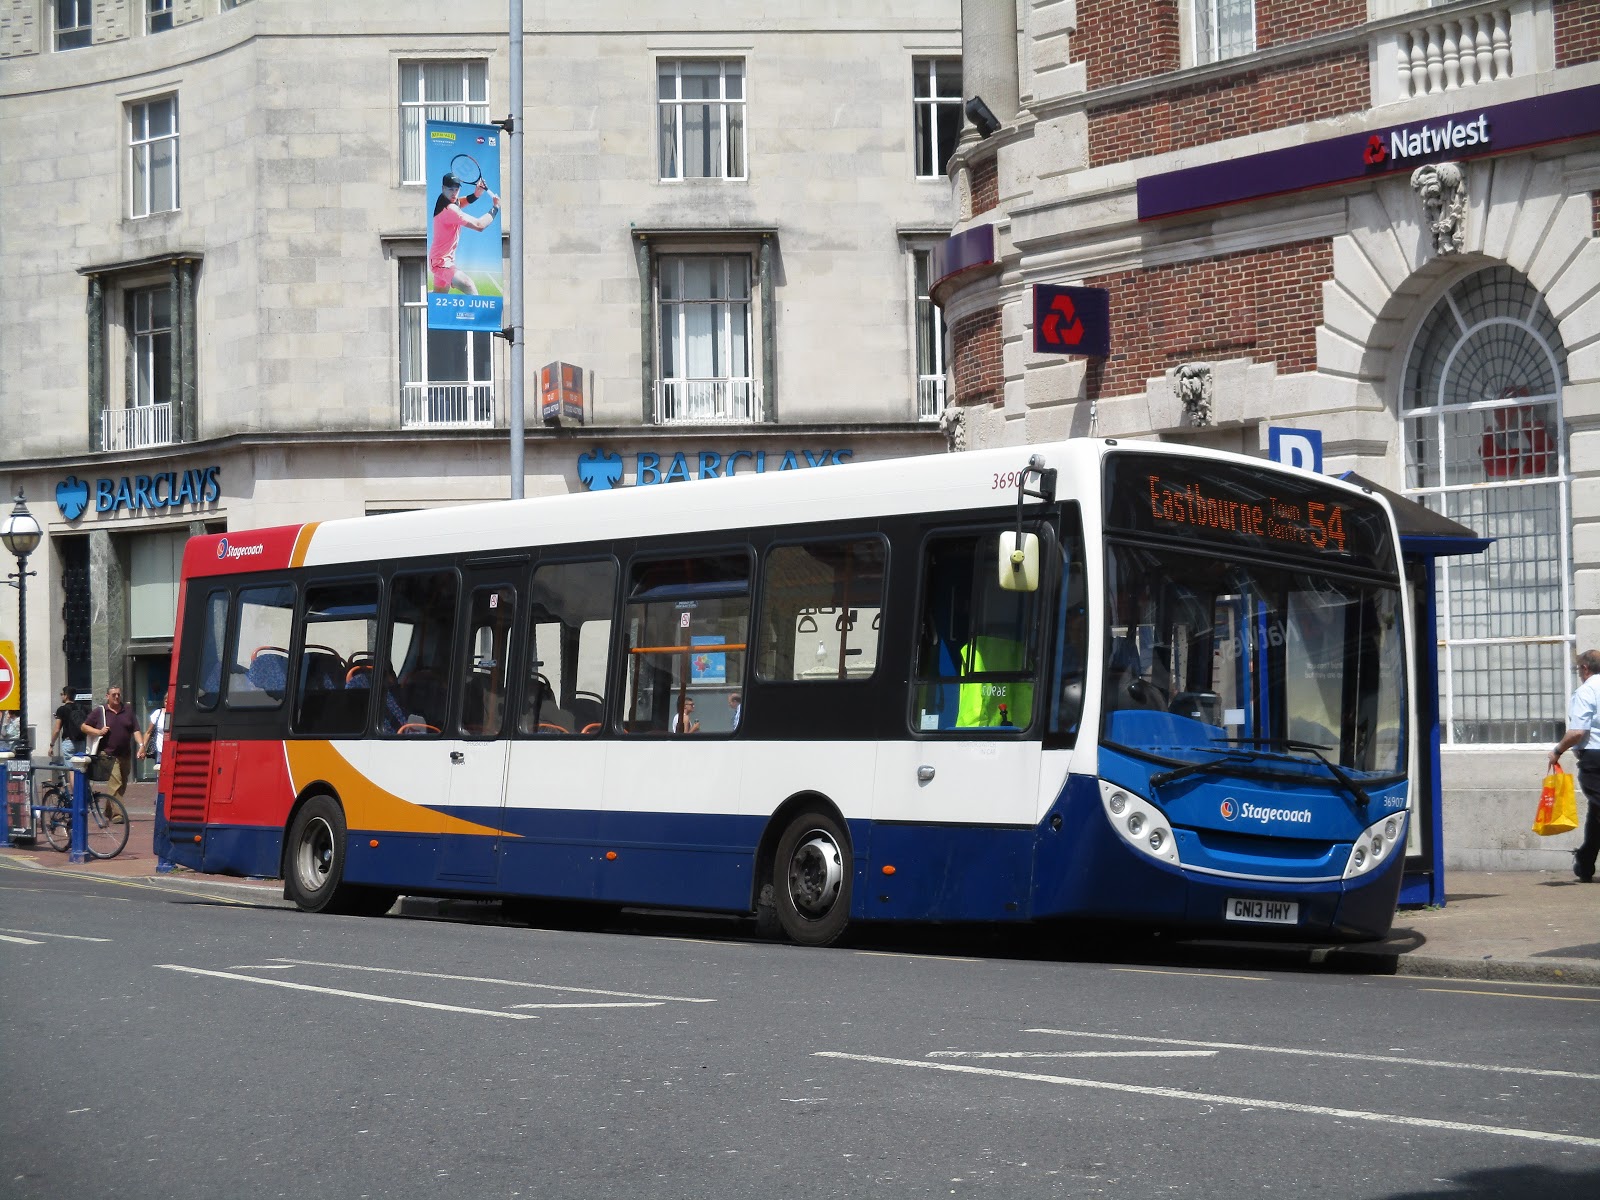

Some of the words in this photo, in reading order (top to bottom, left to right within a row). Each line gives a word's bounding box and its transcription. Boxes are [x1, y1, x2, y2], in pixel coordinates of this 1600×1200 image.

[1391, 113, 1489, 160] NatWest
[435, 298, 465, 307] 22-30
[469, 299, 496, 309] JUNE
[96, 466, 221, 513] BARCLAYS
[1149, 475, 1265, 537] Eastbourne
[1308, 501, 1347, 553] 54
[1269, 497, 1301, 521] Town
[1267, 517, 1307, 544] Centre
[227, 543, 264, 560] Stagecoach
[1241, 802, 1312, 824] Stagecoach
[1383, 795, 1404, 808] 36907
[1234, 900, 1264, 919] GN13
[1265, 902, 1291, 920] HHY
